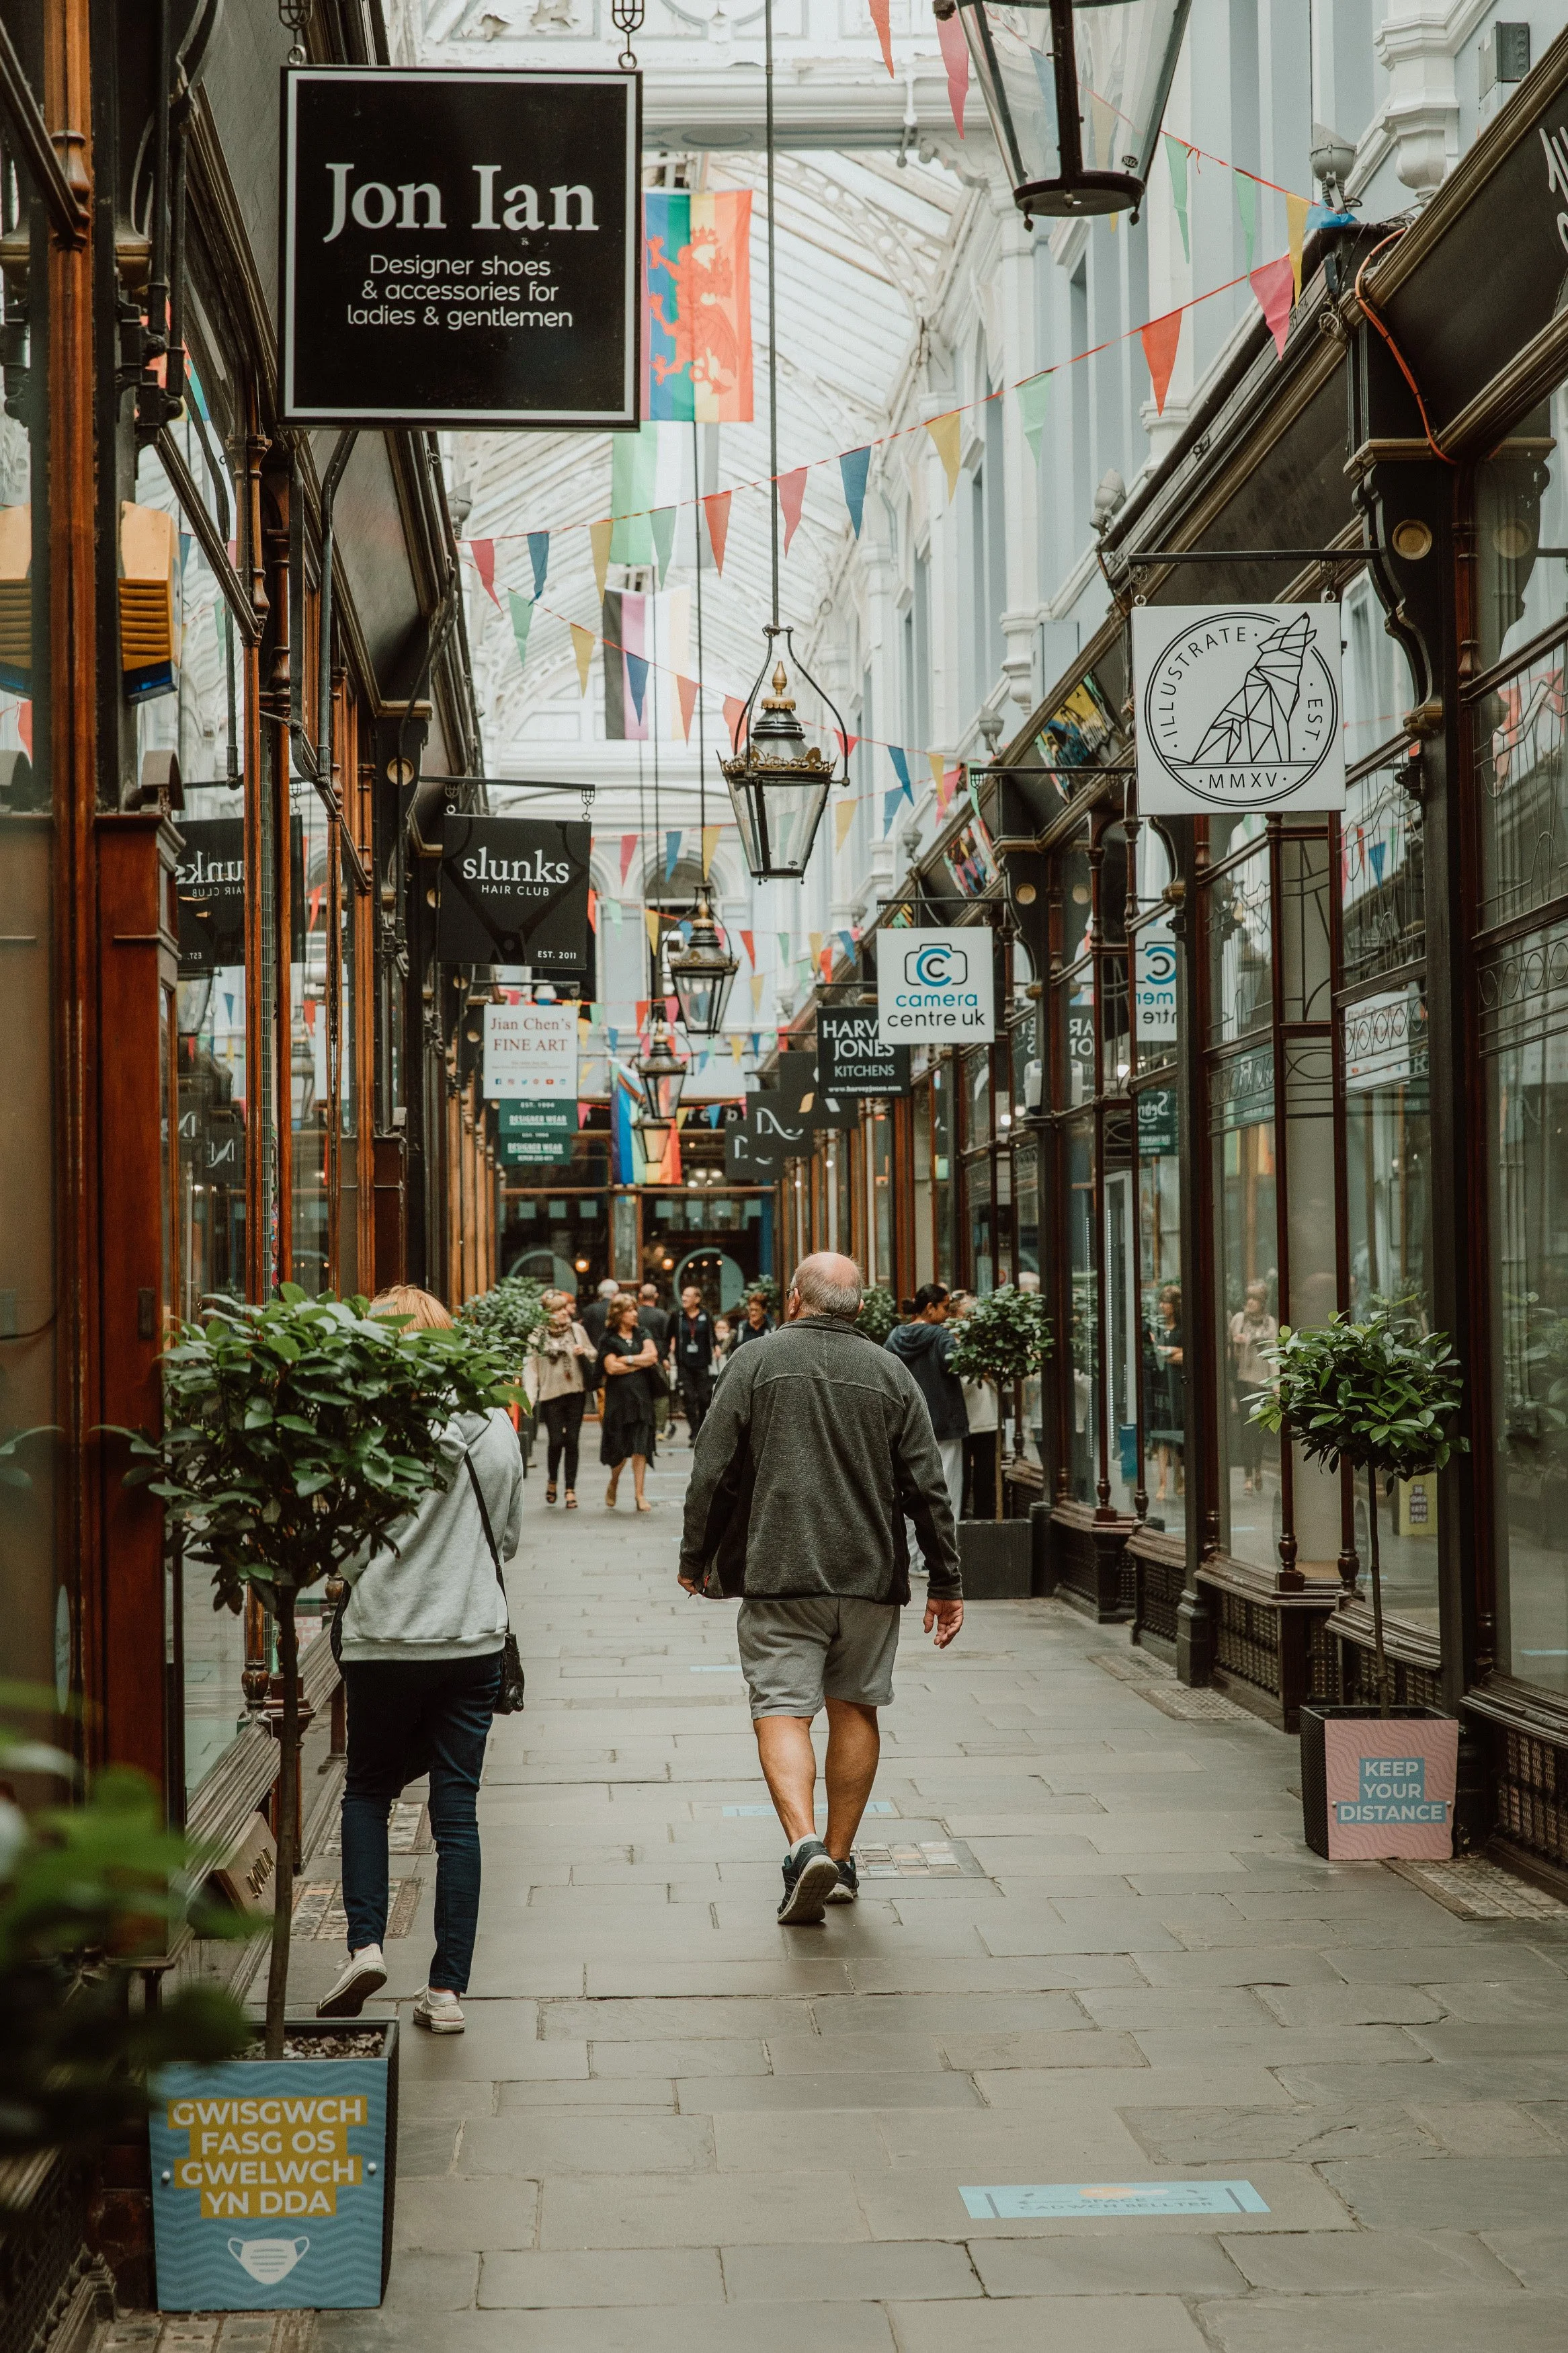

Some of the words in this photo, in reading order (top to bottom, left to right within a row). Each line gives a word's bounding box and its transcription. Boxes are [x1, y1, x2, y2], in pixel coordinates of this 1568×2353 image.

[323, 163, 447, 243] Jon
[471, 165, 599, 231] Ian
[370, 254, 474, 278] Designer
[481, 255, 551, 276] shoes
[362, 280, 378, 299] &
[384, 281, 520, 301] accessories
[528, 281, 559, 301] for
[347, 305, 416, 325] ladies
[423, 307, 440, 326] &
[446, 306, 573, 330] gentlemen
[1159, 627, 1247, 738] ILLUSTRATE
[1305, 698, 1323, 741] EST
[1208, 772, 1278, 789] MMXV
[462, 846, 570, 884] slunks
[481, 885, 511, 895] HAIR
[516, 886, 550, 896] CLUB
[537, 950, 556, 959] EST.
[559, 951, 577, 959] 2011
[896, 994, 978, 1007] camera
[491, 1017, 518, 1031] Jian
[524, 1017, 571, 1031] Chen's
[887, 1011, 956, 1027] centre
[962, 1008, 985, 1026] uk
[823, 1019, 880, 1038] HARV
[493, 1038, 531, 1051] FINE
[535, 1039, 568, 1051] ART
[833, 1039, 895, 1061] JONES
[834, 1064, 895, 1077] KITCHENS
[1364, 1761, 1419, 1777] KEEP
[1362, 1783, 1421, 1799] YOUR
[1340, 1804, 1443, 1821] DISTANCE
[173, 2098, 362, 2126] GWISGWCH
[202, 2130, 282, 2155] FASG
[291, 2130, 336, 2154] OS
[181, 2158, 354, 2186] GWELWCH
[205, 2190, 249, 2215] YN
[259, 2190, 331, 2215] DDA
